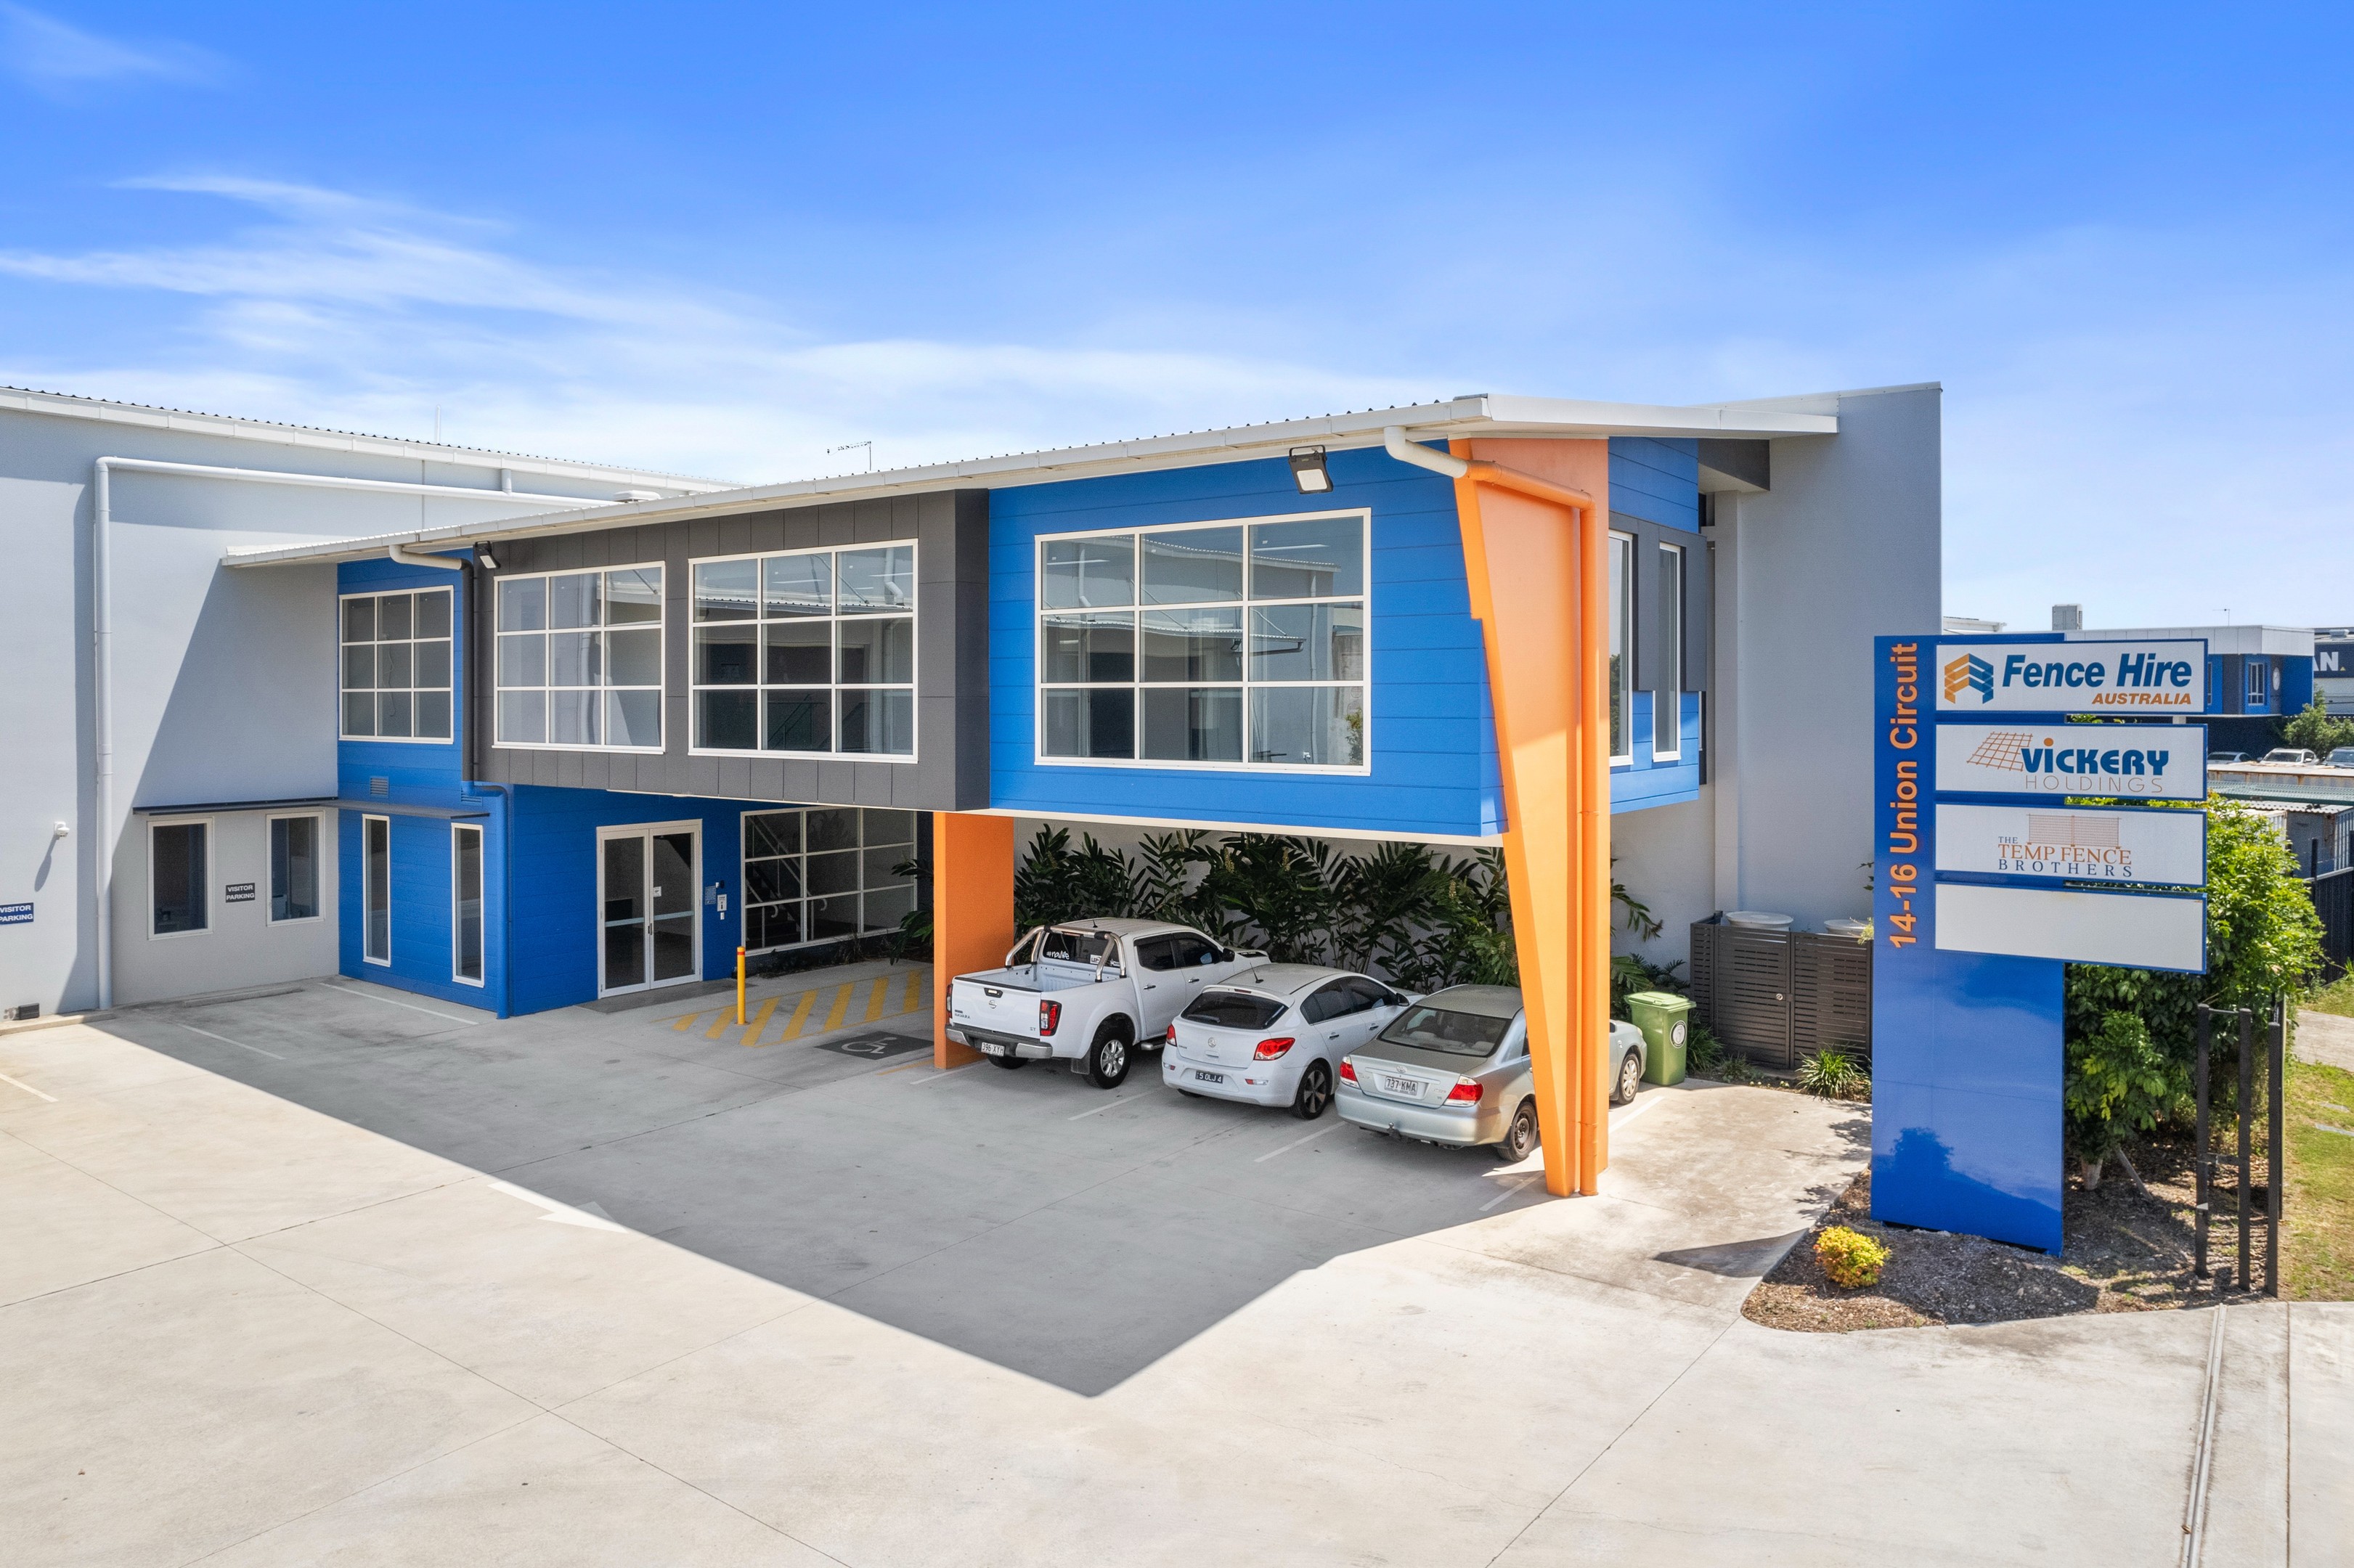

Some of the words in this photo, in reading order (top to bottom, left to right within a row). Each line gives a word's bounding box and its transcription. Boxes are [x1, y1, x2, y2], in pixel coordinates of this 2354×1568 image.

[2002, 654, 2106, 688] Fence
[2116, 653, 2192, 687] Hire
[1889, 642, 1918, 750] Circuit
[2091, 693, 2192, 705] AUSTRALIA
[2024, 775, 2164, 793] HOLDINGS
[1889, 761, 1918, 854] Union
[1998, 844, 2056, 861] TEMP
[2061, 846, 2132, 865] FENCE
[1999, 859, 2133, 878] BROTHERS
[0, 905, 31, 913] VISITOR
[1889, 864, 1918, 948] 14-16
